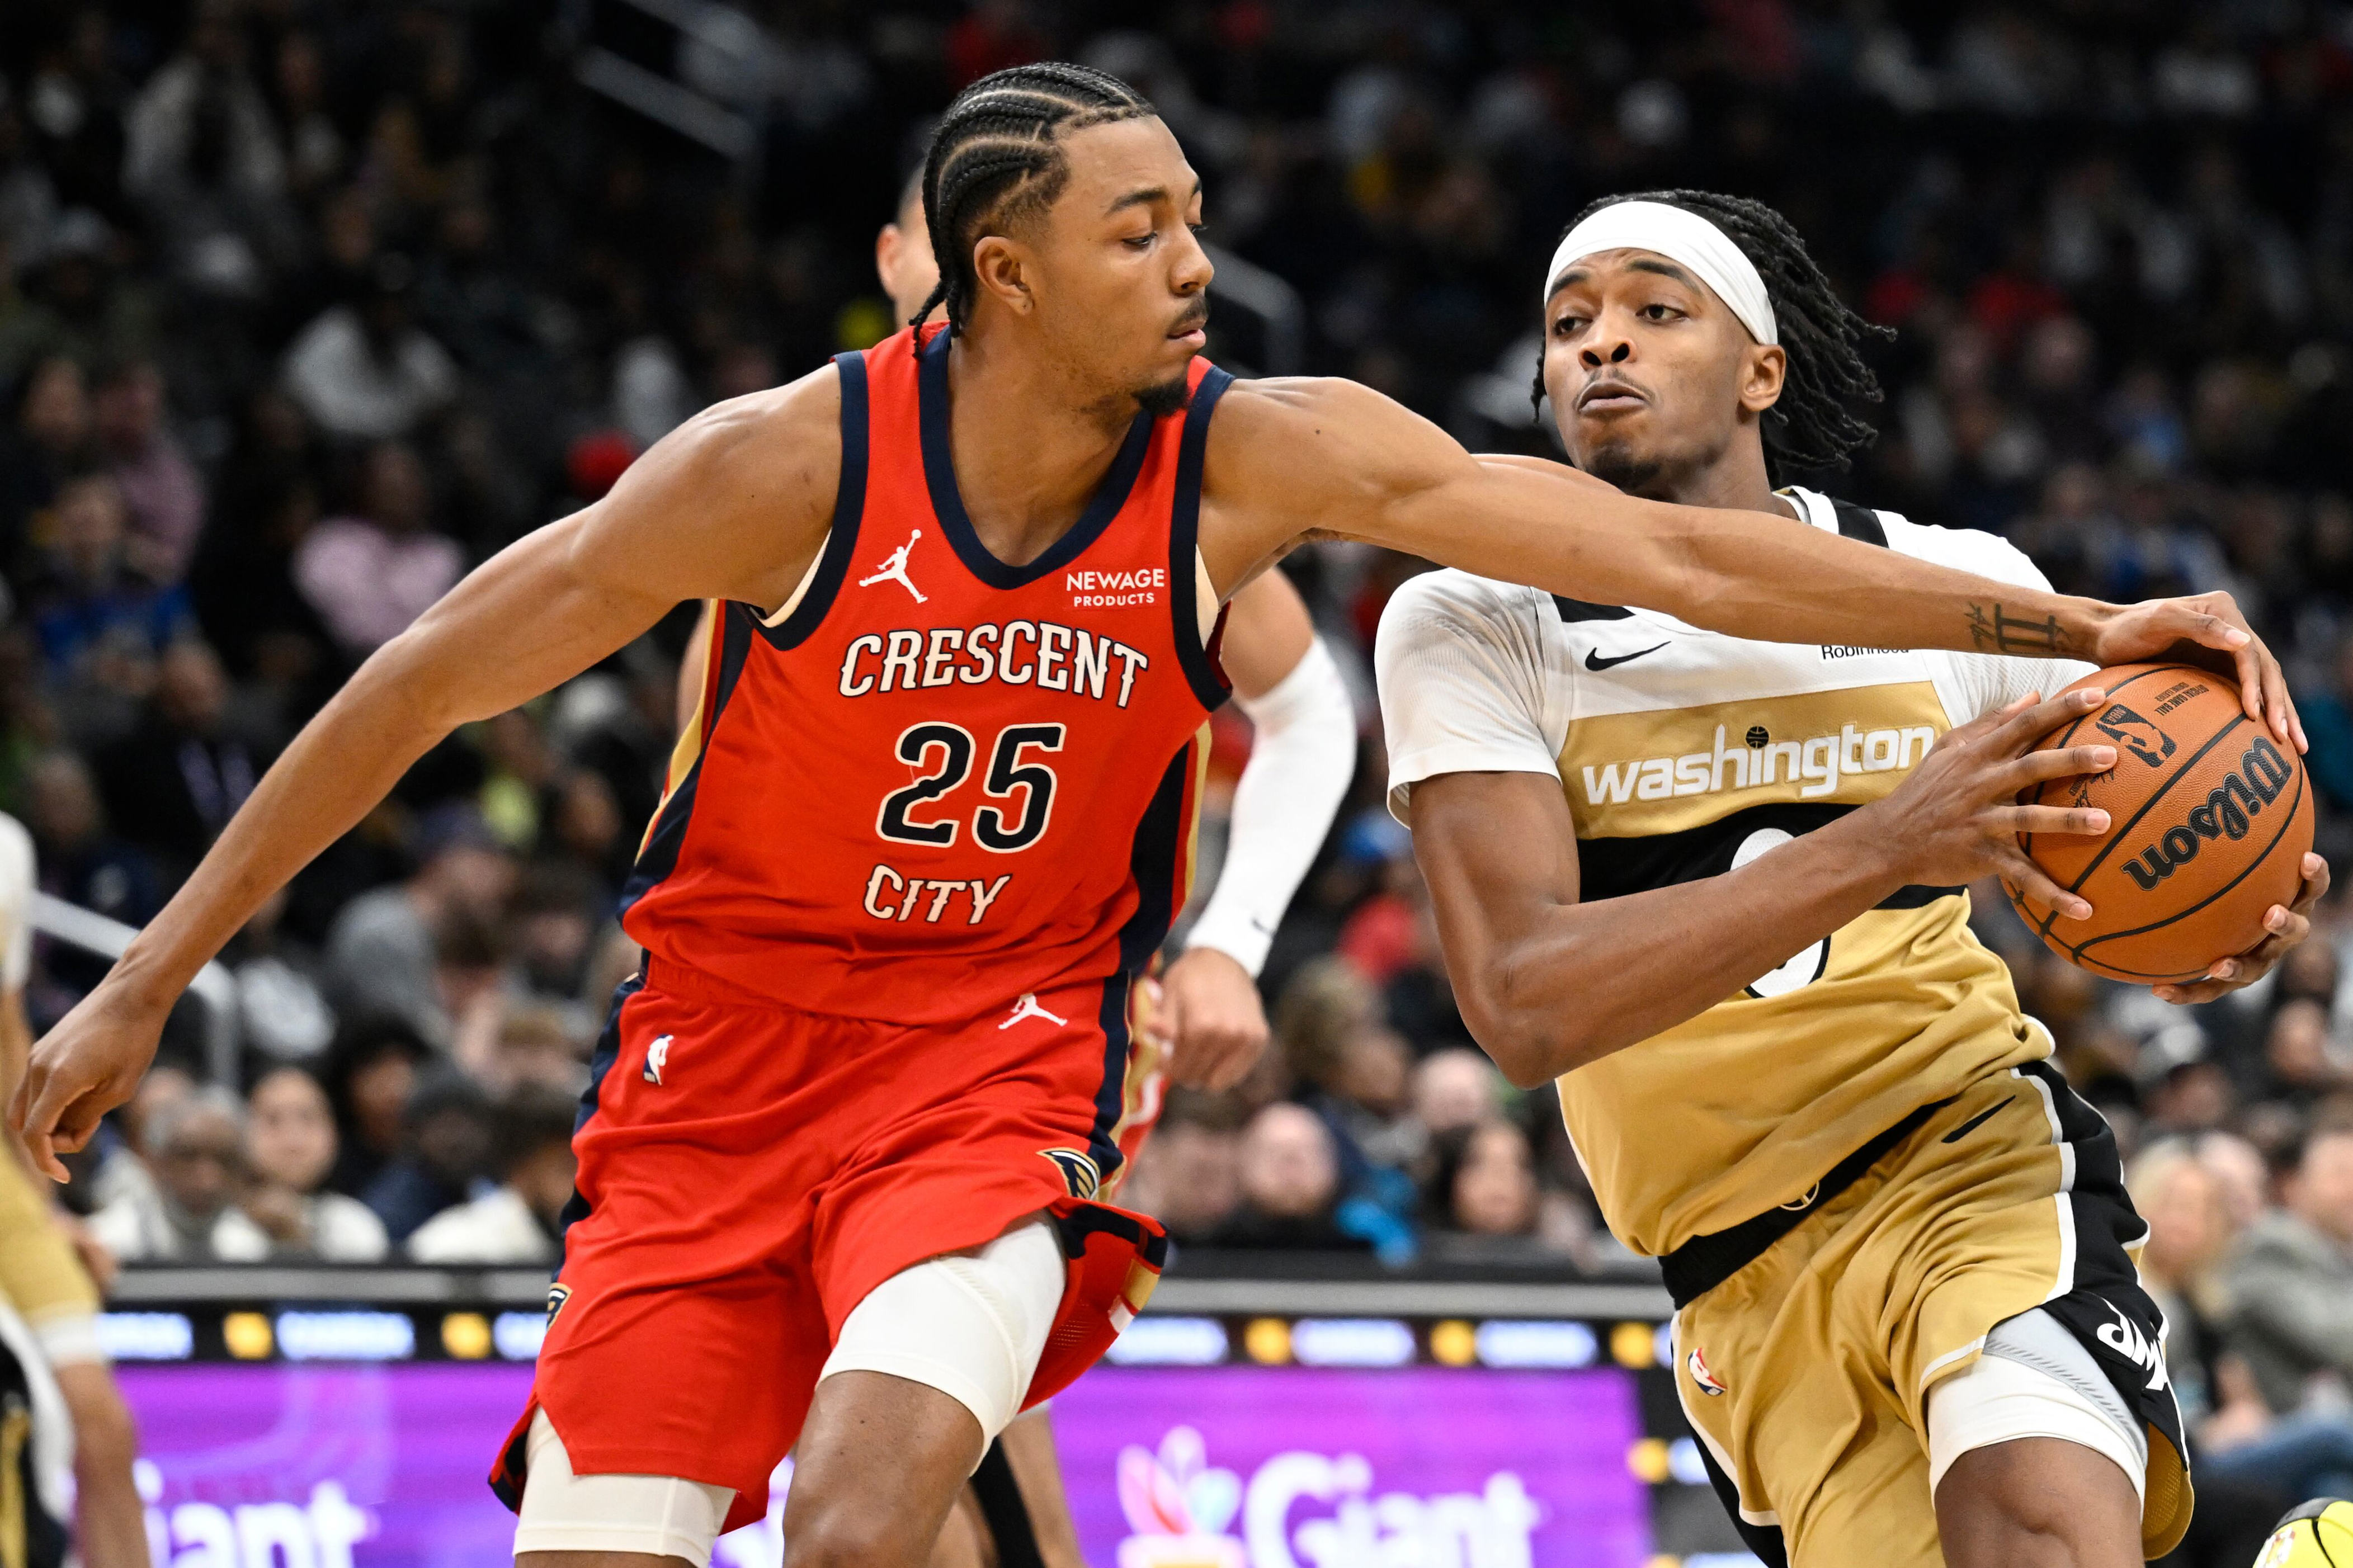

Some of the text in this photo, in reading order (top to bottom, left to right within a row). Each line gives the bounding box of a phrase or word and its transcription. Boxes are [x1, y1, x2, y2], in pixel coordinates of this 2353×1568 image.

[1066, 568, 1165, 592] NEWAGE
[1073, 592, 1155, 607] PRODUCTS
[839, 619, 1148, 709] CRESCENT
[2106, 707, 2125, 723] NBA
[2154, 702, 2174, 716] BALL
[875, 721, 1067, 853] 25
[1582, 724, 1936, 805] washington
[2120, 736, 2294, 891] Wilson
[864, 864, 1013, 925] CITY
[132, 1458, 370, 1568] iant
